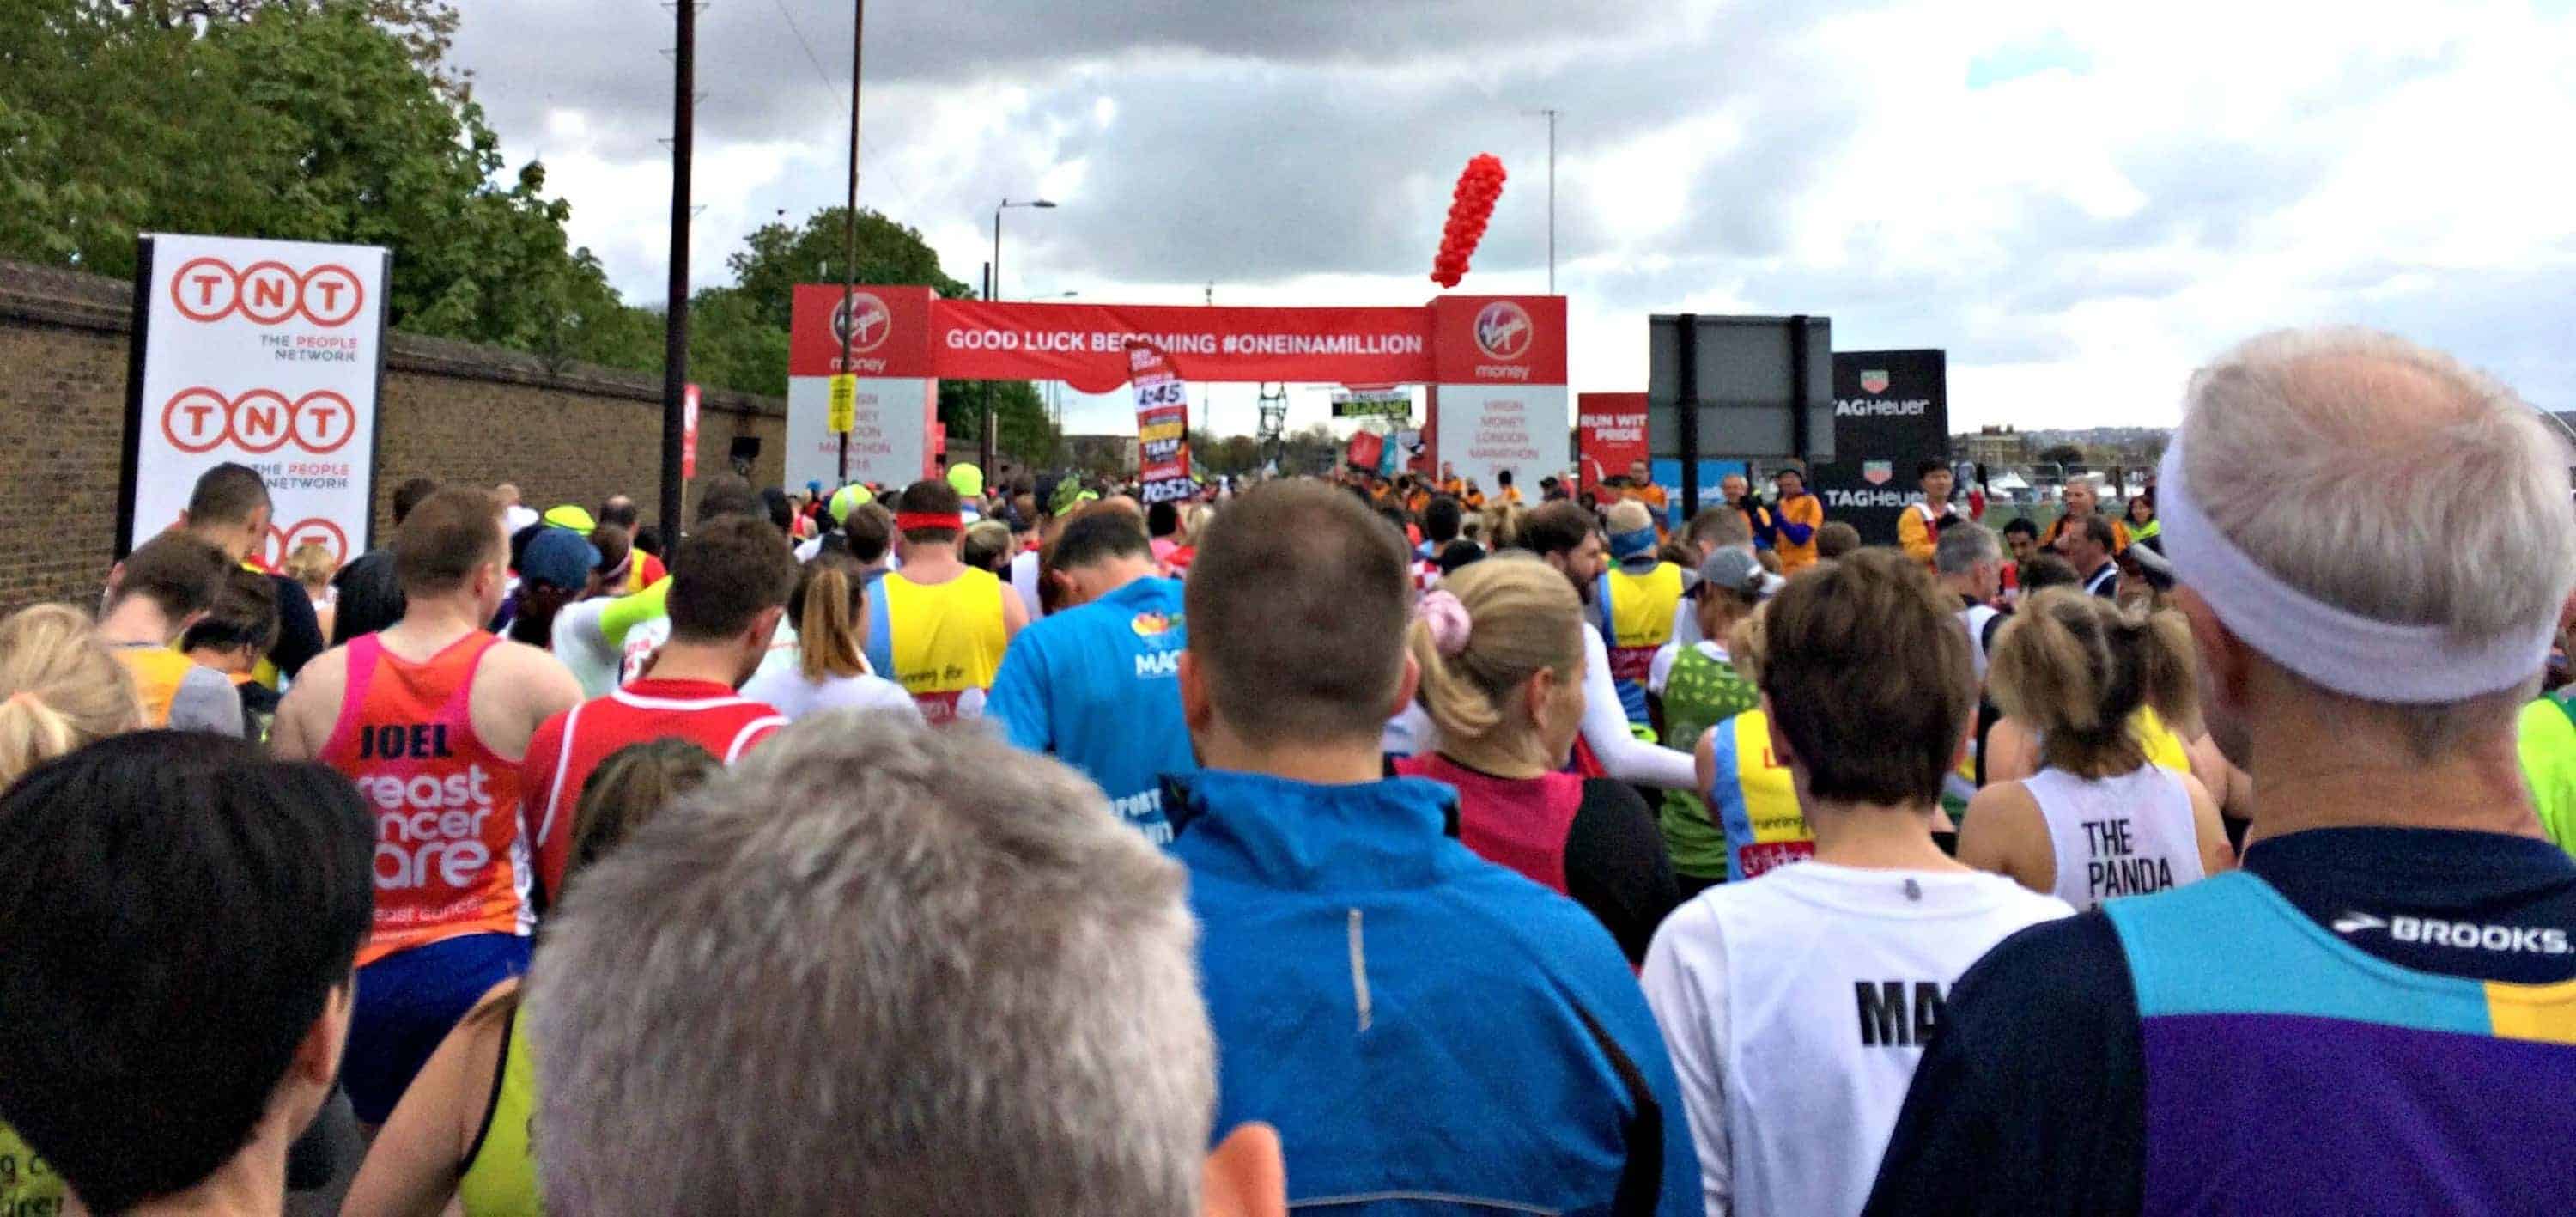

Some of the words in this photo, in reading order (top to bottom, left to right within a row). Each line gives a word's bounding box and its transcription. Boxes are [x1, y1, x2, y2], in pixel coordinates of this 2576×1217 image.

[260, 334, 289, 346] THE
[295, 335, 358, 349] PEOPLE
[946, 329, 1018, 350] GOOD
[1024, 331, 1086, 351] LUCK
[1222, 333, 1424, 356] #ONEINAMILLION
[275, 349, 355, 362] NETWORK
[1475, 364, 1531, 380] money
[1580, 414, 1613, 427] RUN
[1616, 413, 1648, 427] WIT
[1476, 431, 1529, 443] LONDON
[266, 477, 349, 490] NETWORK
[288, 464, 349, 476] PEOPLE
[360, 723, 453, 760] JOEL
[356, 764, 492, 809] reast
[378, 807, 492, 843] ncer
[2081, 818, 2133, 856] THE
[374, 839, 490, 890] are
[2088, 857, 2174, 898] PANDA
[1854, 981, 1956, 1048] MA
